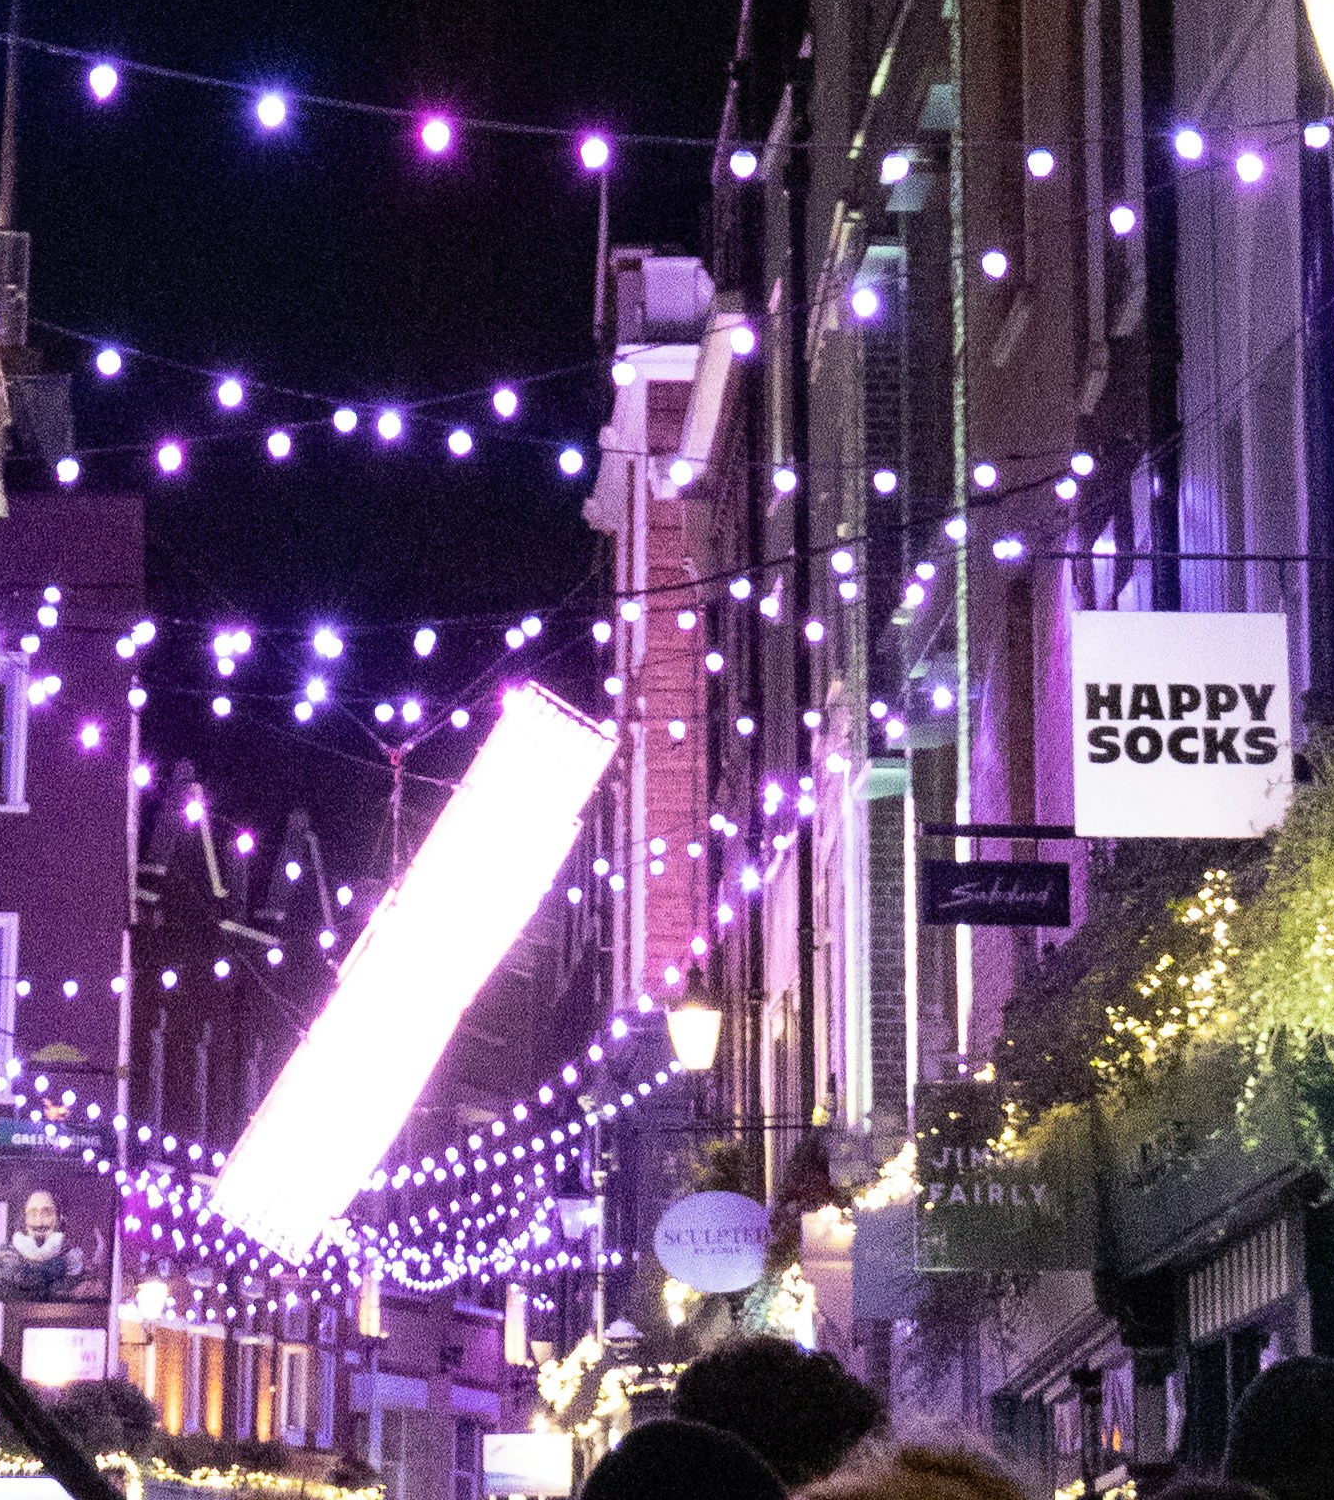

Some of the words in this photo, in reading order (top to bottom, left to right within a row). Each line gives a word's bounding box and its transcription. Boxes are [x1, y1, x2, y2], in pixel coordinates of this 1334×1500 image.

[1084, 682, 1275, 721] HAPPY
[1087, 725, 1278, 765] SOCKS
[928, 1182, 1047, 1206] FAIRLY
